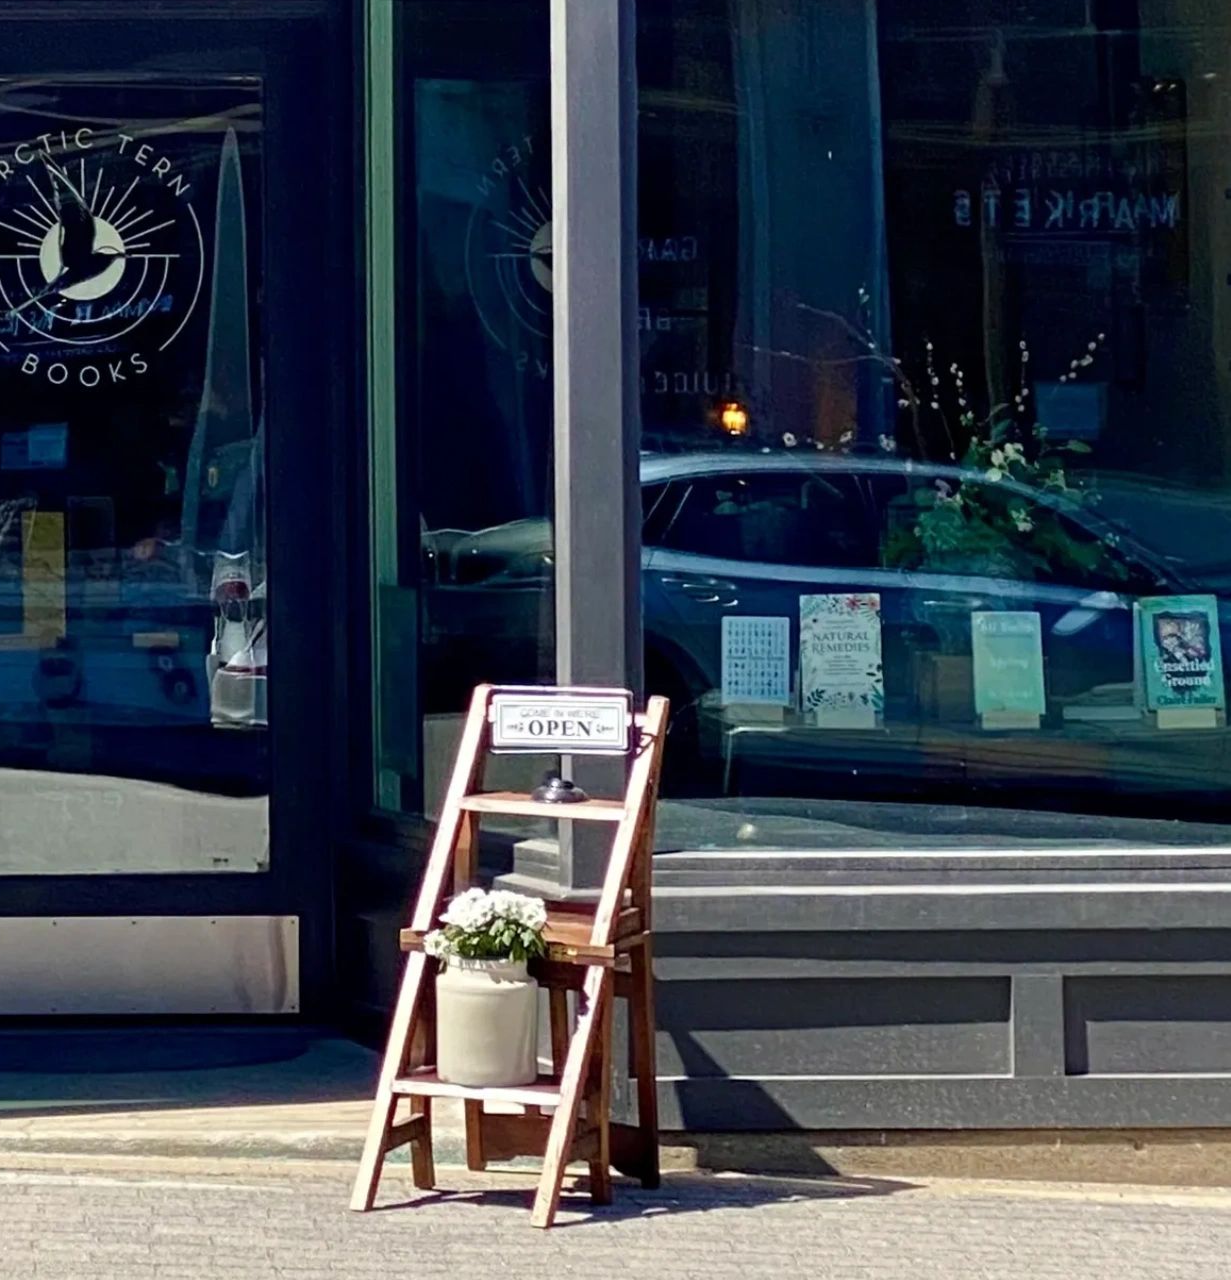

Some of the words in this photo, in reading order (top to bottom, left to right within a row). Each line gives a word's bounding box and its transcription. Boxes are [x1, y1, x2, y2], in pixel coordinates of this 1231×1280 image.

[117, 134, 191, 199] TERN
[21, 351, 150, 387] BOOKS
[812, 631, 870, 641] NATURAL
[812, 642, 871, 654] REMEDIES
[528, 719, 593, 737] OPEN
